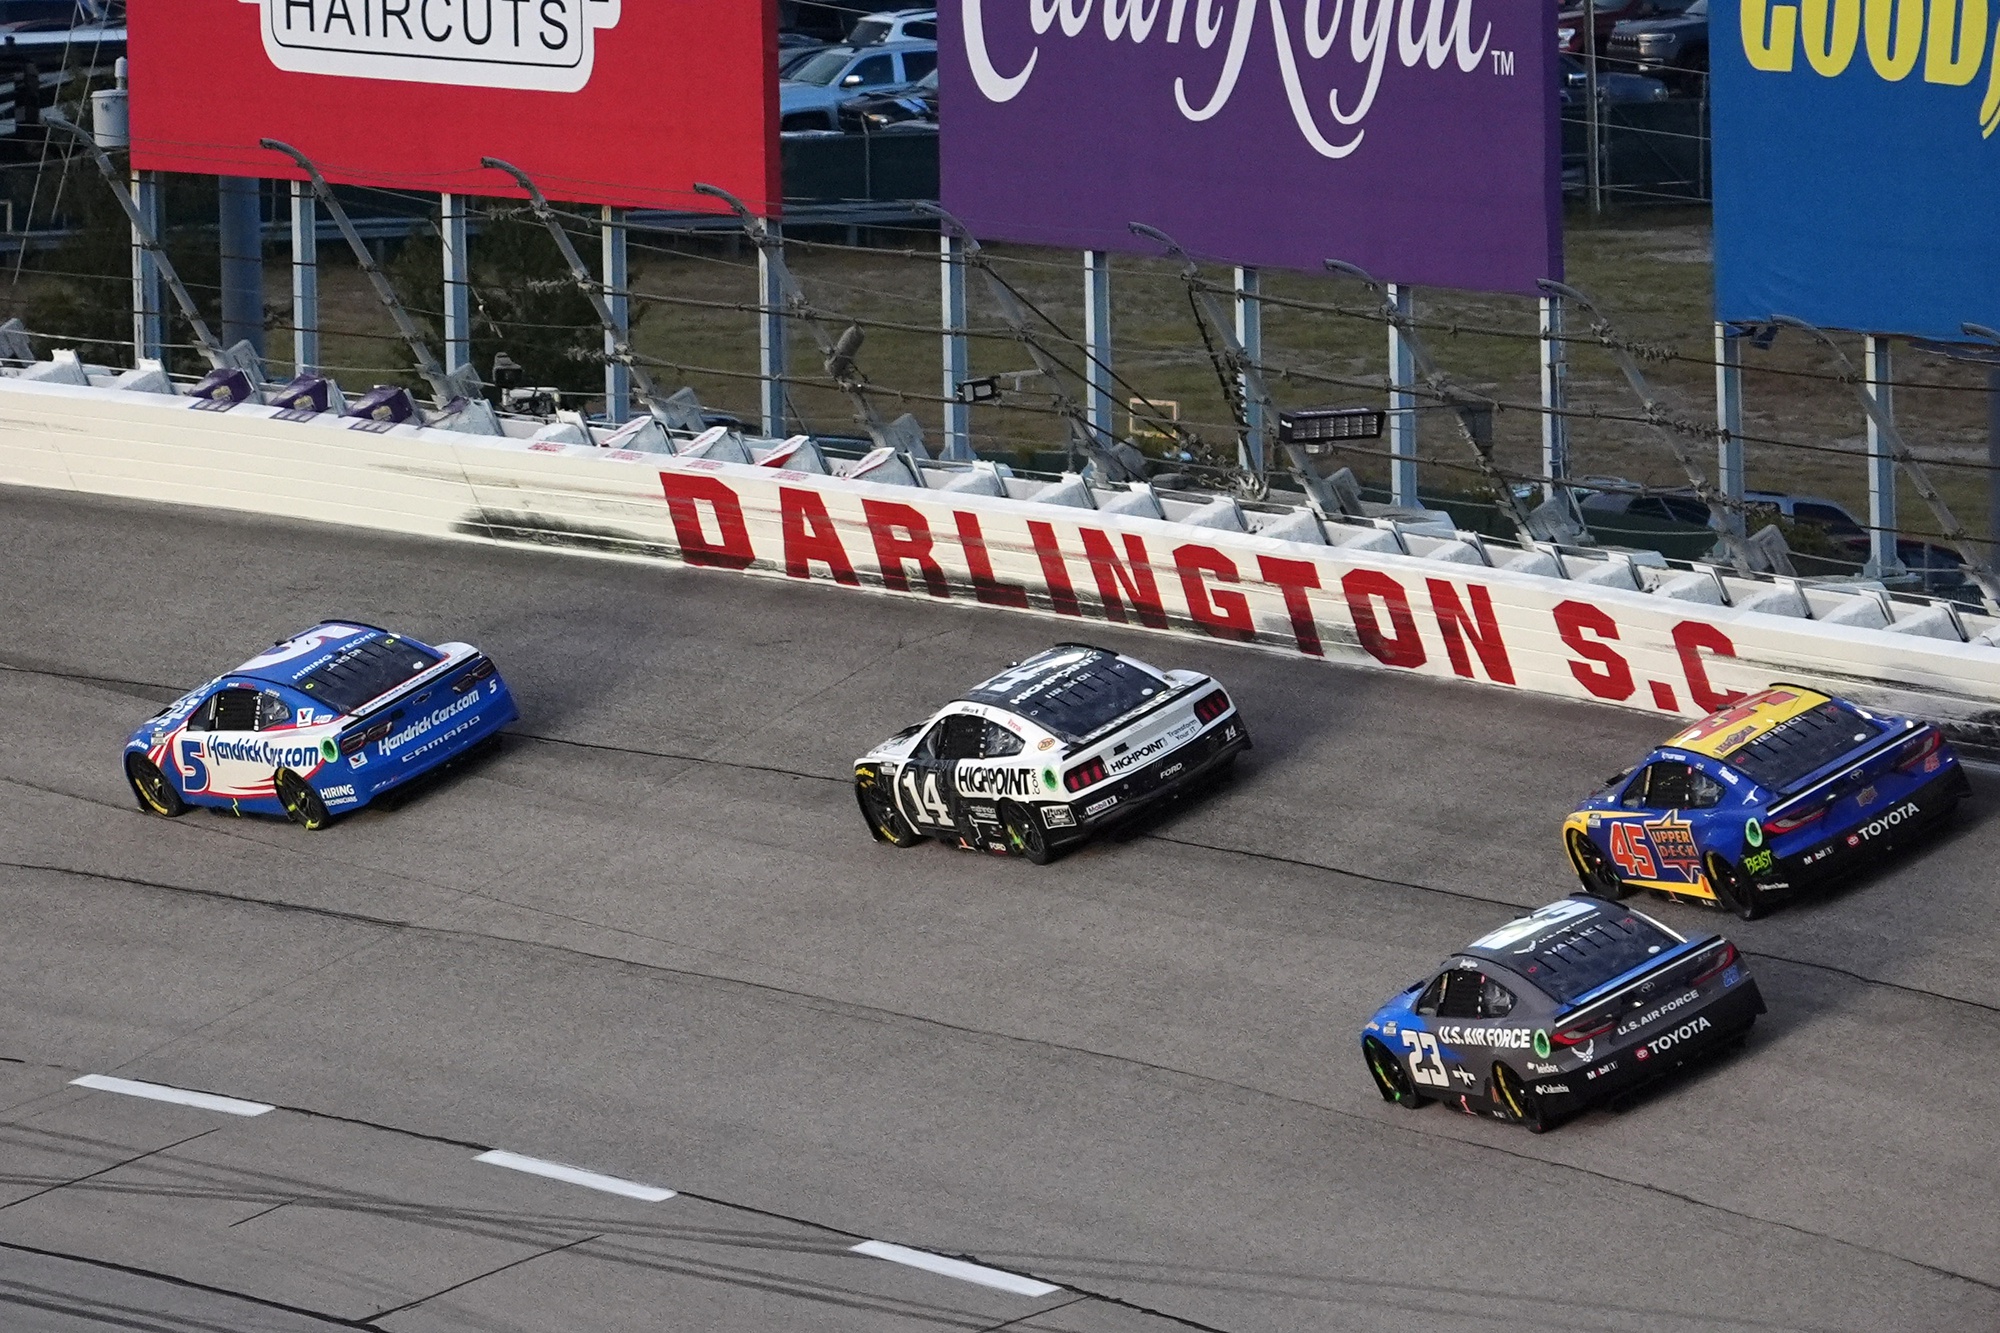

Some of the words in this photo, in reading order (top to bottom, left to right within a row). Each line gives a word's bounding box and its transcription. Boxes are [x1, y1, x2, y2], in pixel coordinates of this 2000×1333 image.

[286, 0, 570, 51] HAIRCUTS
[659, 471, 1516, 686] DARLINGTON
[291, 654, 332, 680] HIRING
[337, 631, 377, 653] TECHS
[489, 679, 498, 694] 5
[401, 715, 480, 763] CAMARO
[1166, 719, 1197, 738] Transform
[1175, 731, 1190, 740] Your
[1223, 725, 1237, 742] 14
[180, 738, 210, 792] 5
[1110, 738, 1165, 773] HIGHPOINT
[1160, 762, 1183, 779] FORD
[320, 784, 355, 799] HIRING
[958, 766, 1030, 796] HIGHPOINT
[901, 768, 955, 828] 14
[1088, 800, 1107, 813] Mobil
[1858, 802, 1921, 841] TOYOTA
[1609, 820, 1658, 880] 45
[1651, 830, 1692, 844] UPPER
[1744, 849, 1773, 875] BEAST
[1617, 1021, 1641, 1036] U.S.
[1641, 1011, 1661, 1026] AIR
[1660, 989, 1700, 1015] FORCE
[1438, 1026, 1464, 1045] U.S.
[1465, 1027, 1487, 1046] AIR
[1486, 1028, 1531, 1049] FORCE
[1648, 1016, 1712, 1055] TOYOTA
[1401, 1029, 1450, 1087] 23
[1535, 1063, 1559, 1074] leidos
[1542, 1084, 1570, 1094] Columbia
